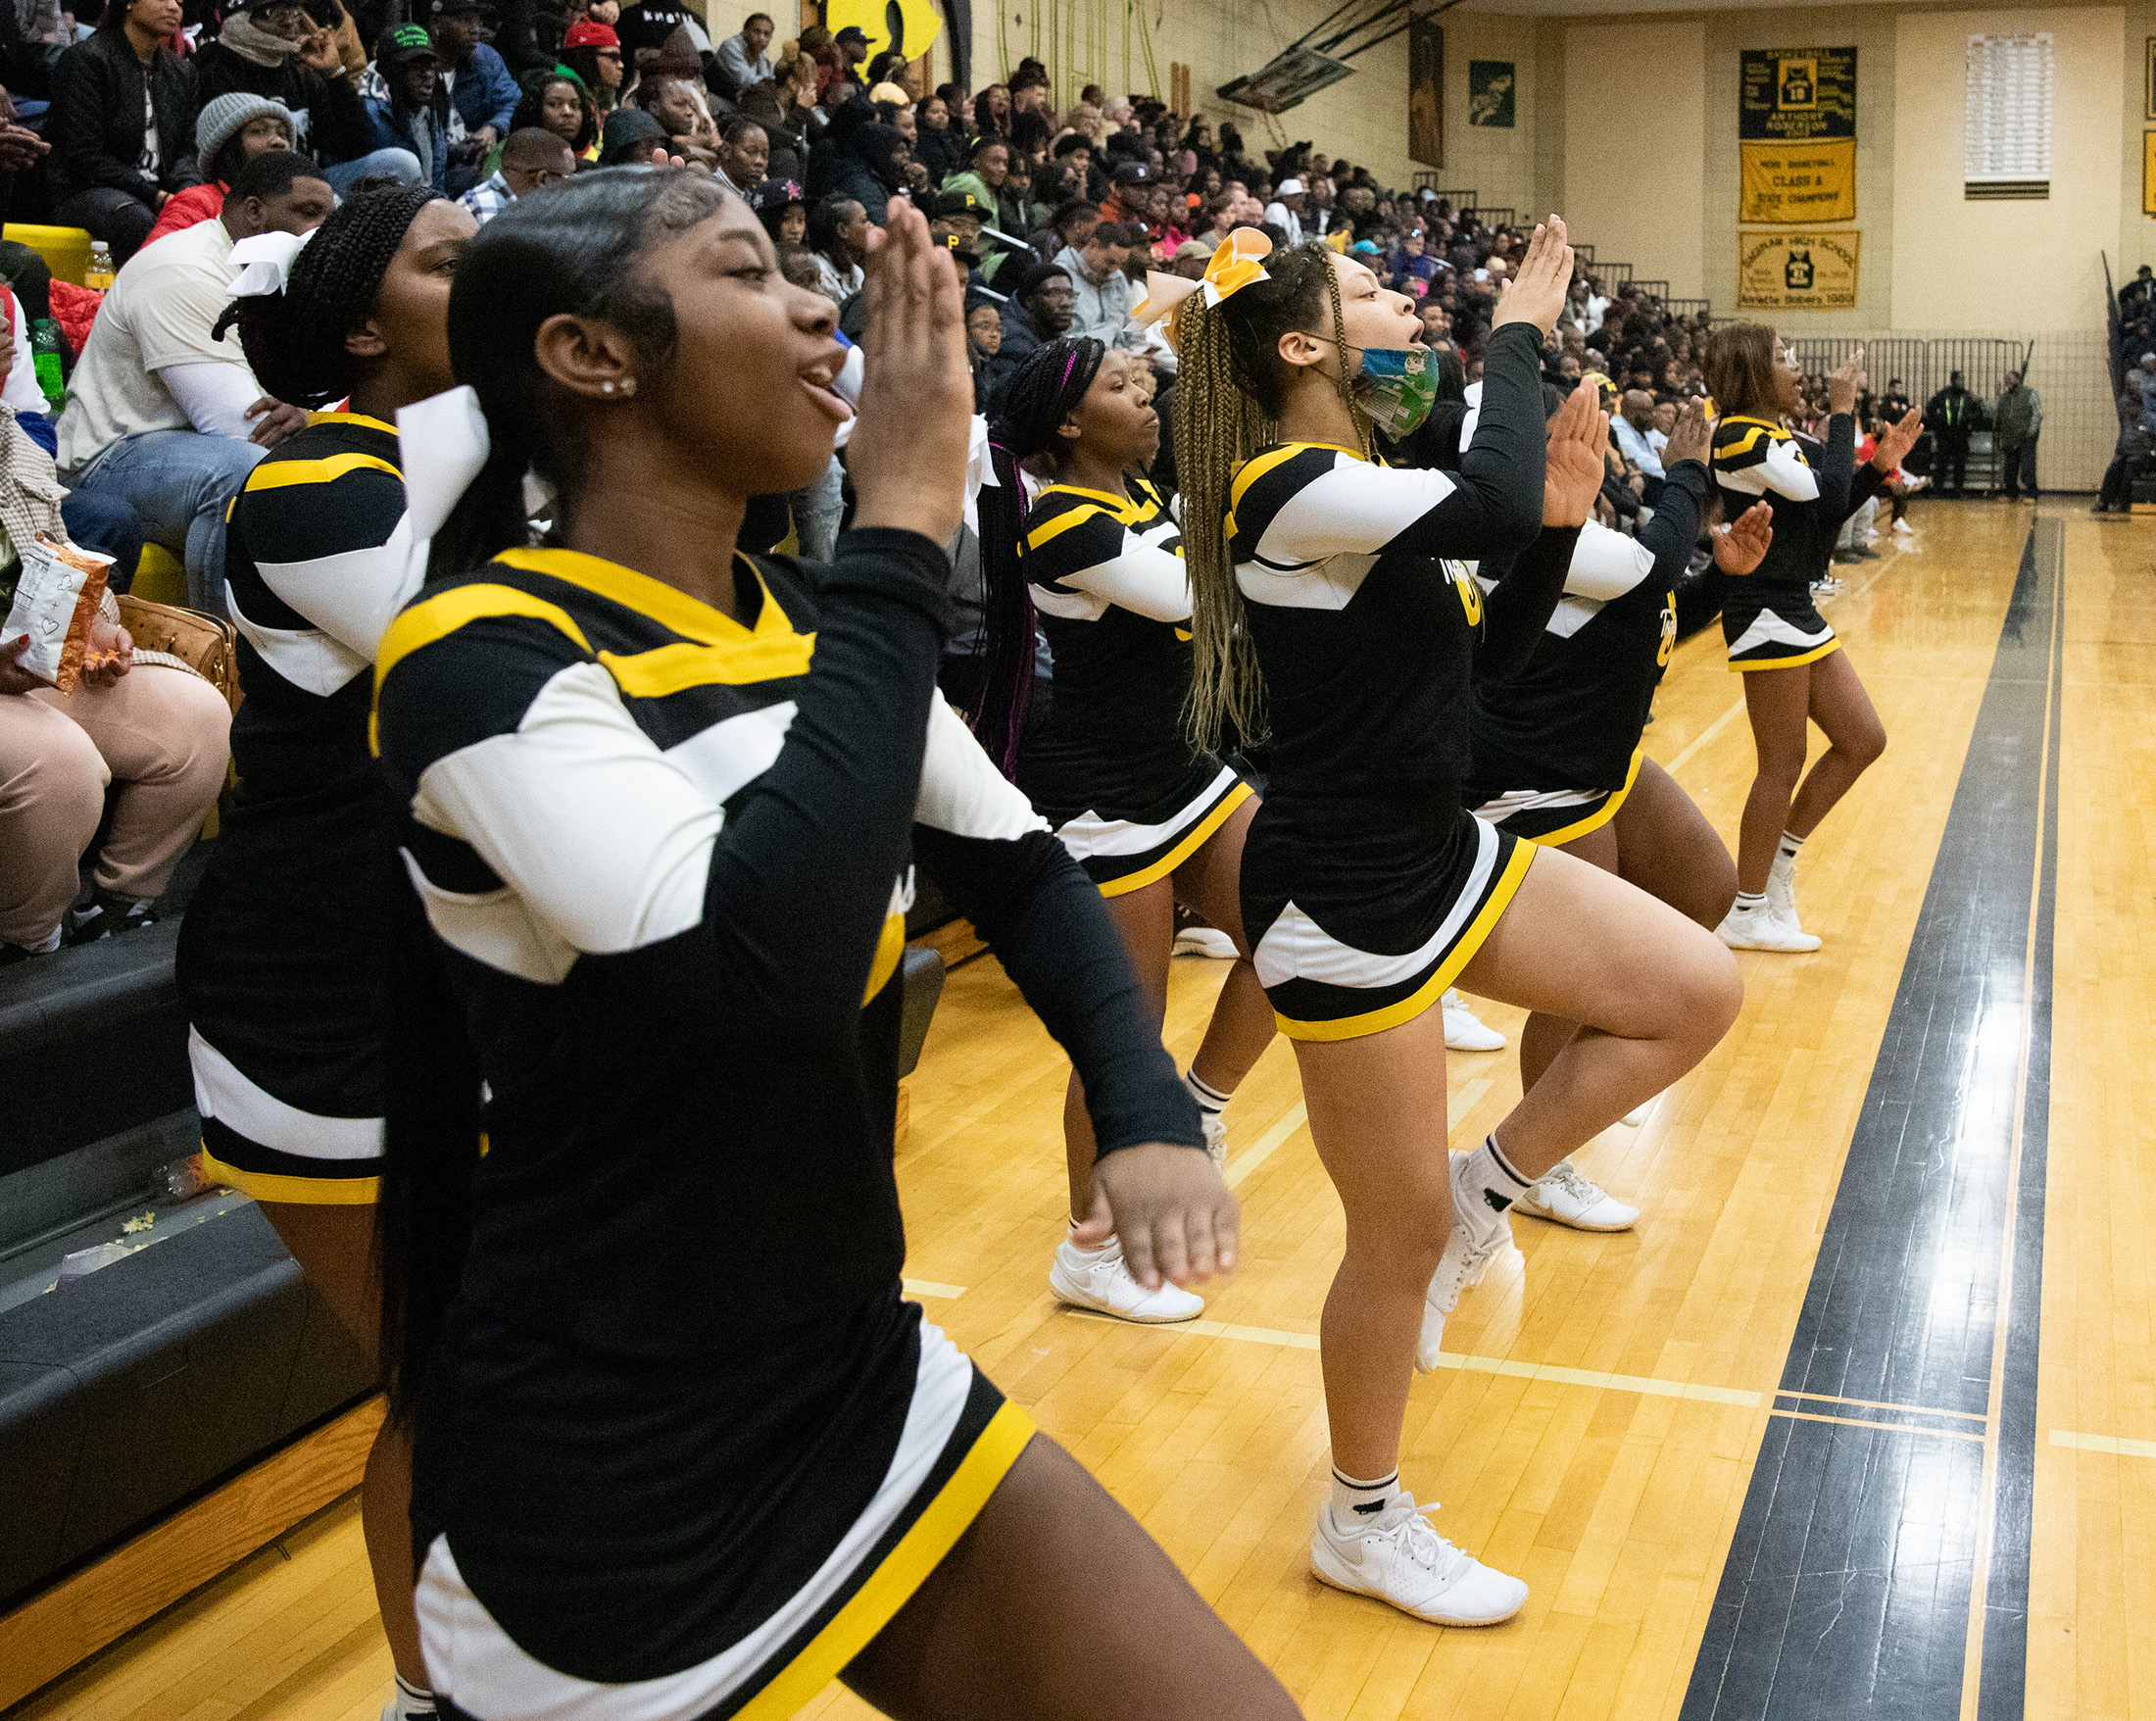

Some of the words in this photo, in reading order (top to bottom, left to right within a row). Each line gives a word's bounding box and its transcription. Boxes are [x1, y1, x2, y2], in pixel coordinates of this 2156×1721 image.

[1772, 174, 1811, 187] CLASS
[1815, 174, 1823, 186] A
[948, 235, 959, 250] P
